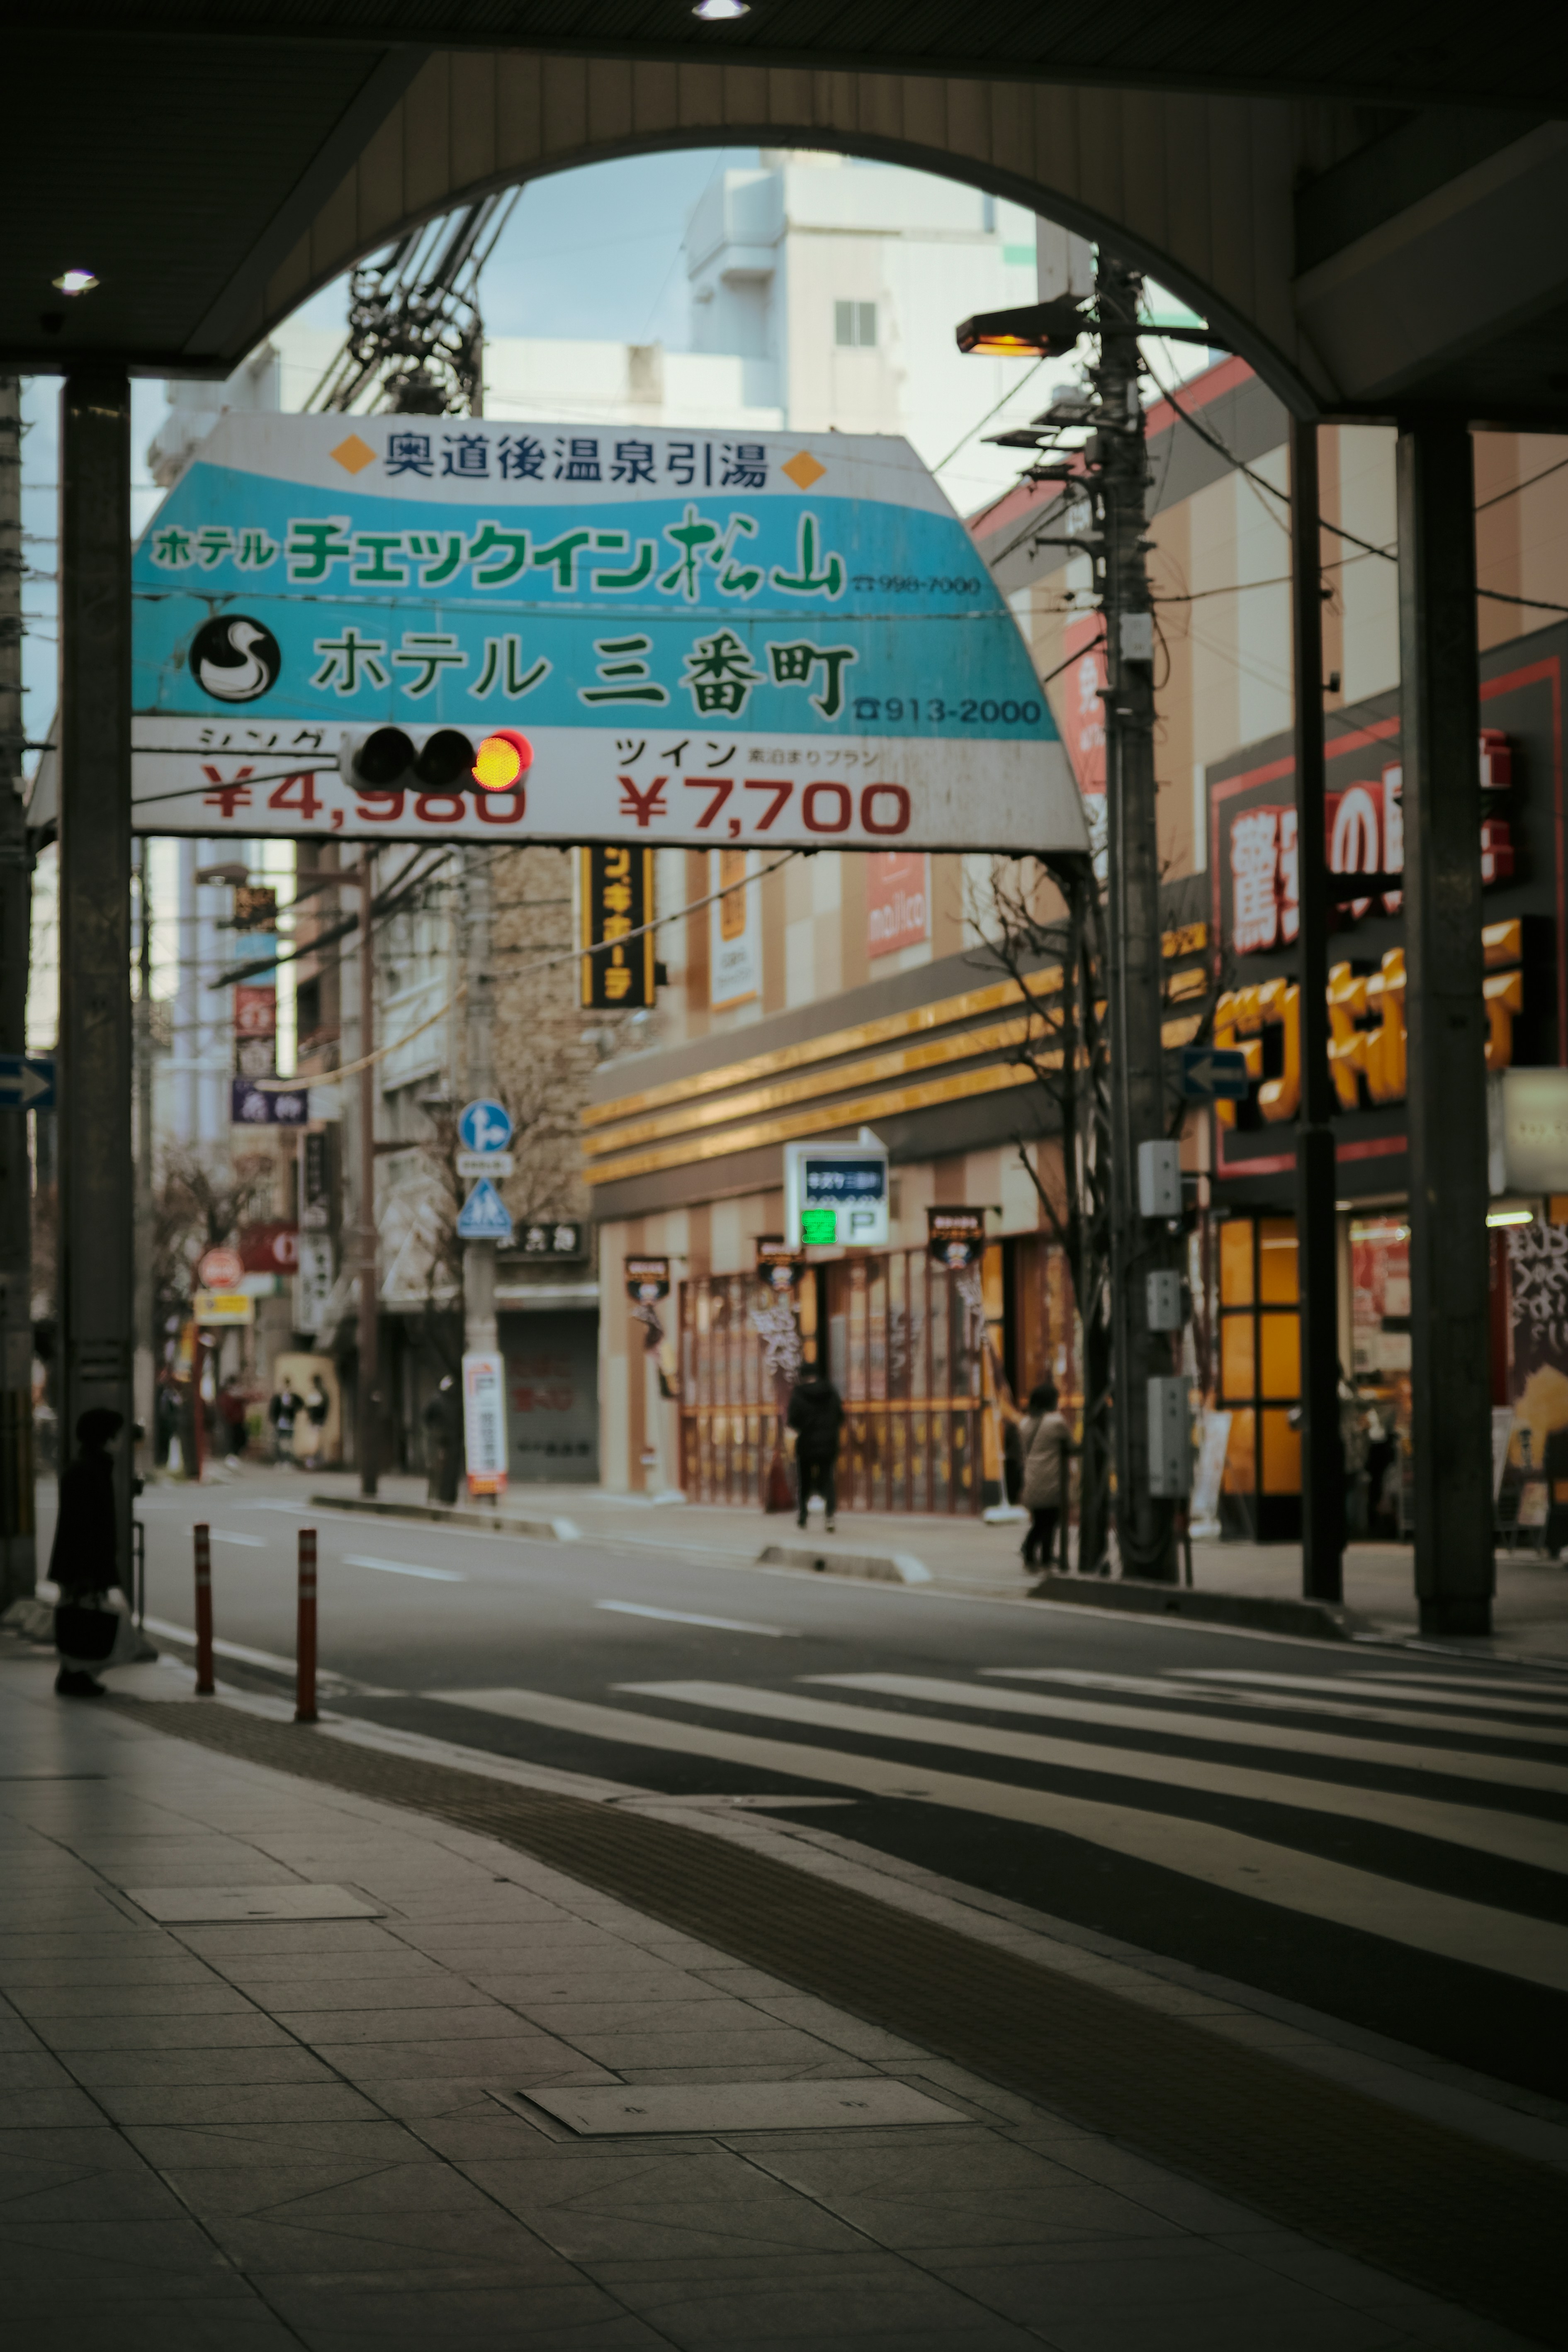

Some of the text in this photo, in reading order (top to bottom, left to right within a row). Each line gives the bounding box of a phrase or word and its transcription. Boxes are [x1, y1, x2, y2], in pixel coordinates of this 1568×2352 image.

[385, 432, 768, 488] 奥道後温泉引湯
[153, 527, 278, 569] ホテル
[287, 506, 843, 599] チェックイン松山
[312, 628, 549, 696] ホテル
[583, 630, 856, 719] 三番町
[885, 698, 1040, 724] 913-2000
[617, 739, 736, 768] ツイン
[618, 776, 911, 838] ¥7,700
